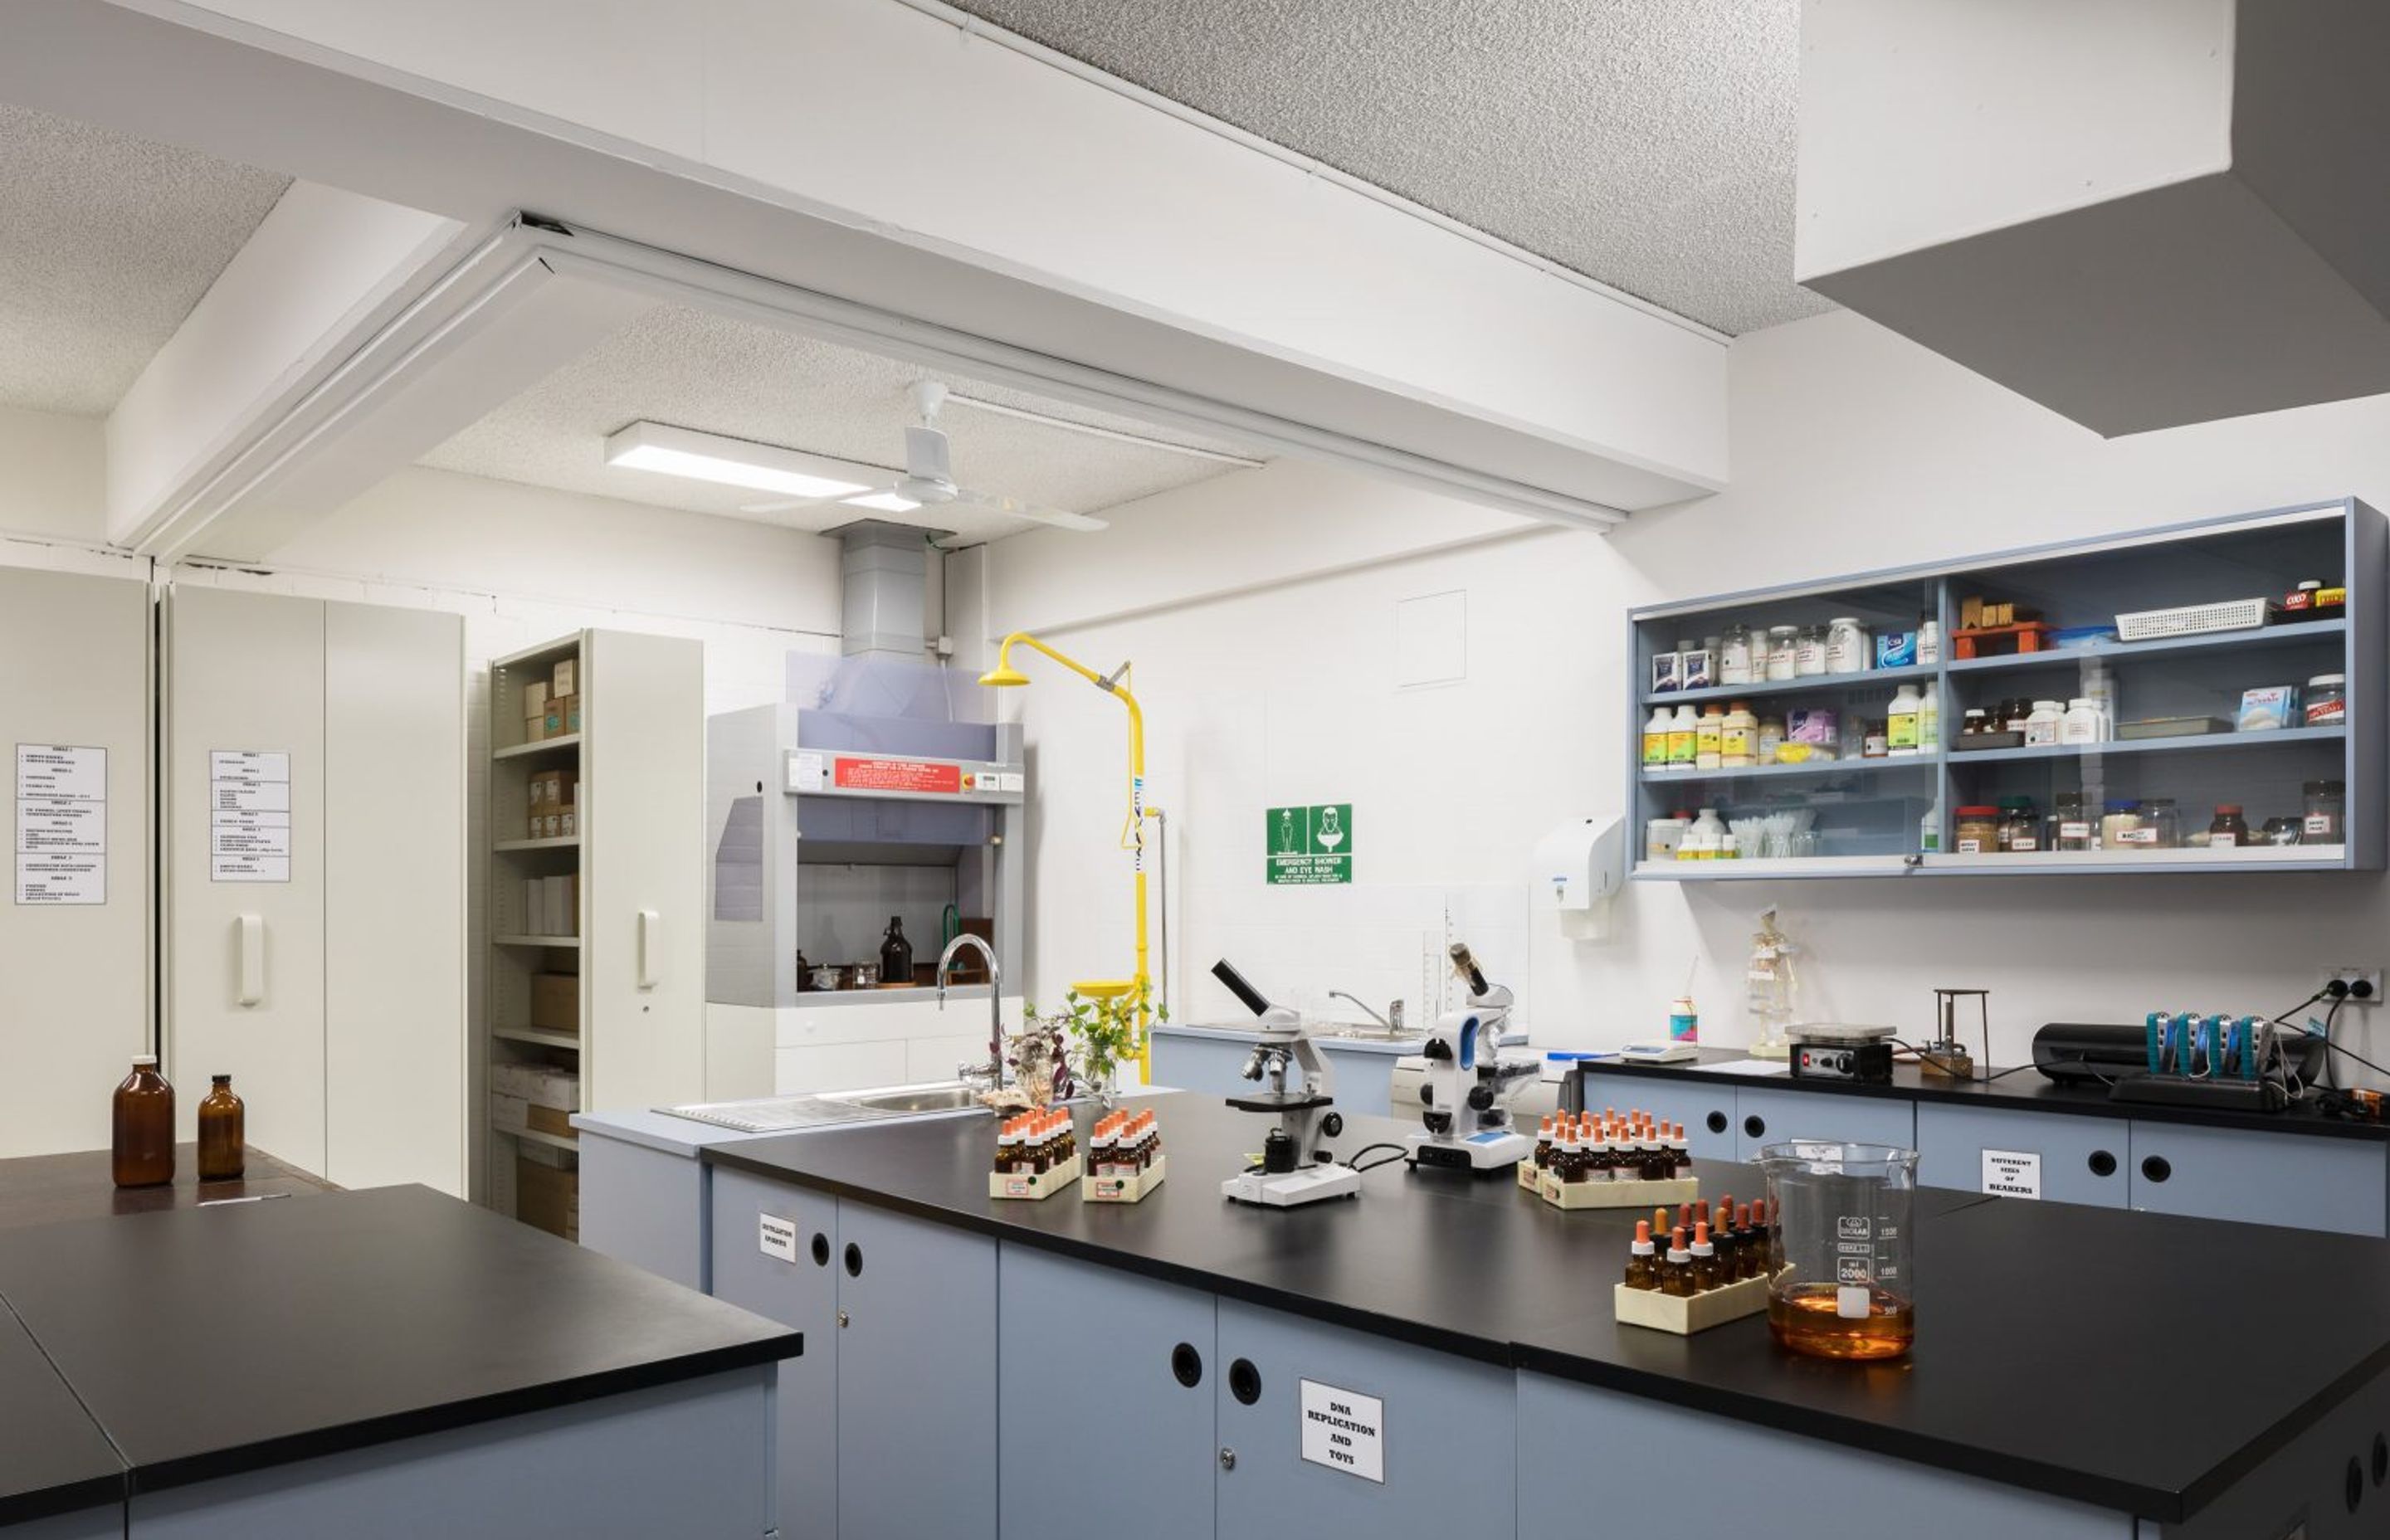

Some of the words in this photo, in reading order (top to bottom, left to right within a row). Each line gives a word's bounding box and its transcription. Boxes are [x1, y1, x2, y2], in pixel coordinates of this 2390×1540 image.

[1275, 858, 1312, 866] EMERGENCY
[1314, 857, 1342, 865] SHOWER
[1314, 865, 1333, 874] WASH
[1991, 1157, 2032, 1167] DIFFERENT
[1988, 1183, 2032, 1195] BEAKERS
[1841, 1267, 1867, 1279] 2000
[1330, 1401, 1352, 1416] DNA
[1307, 1409, 1376, 1437] REPLICATION
[1329, 1433, 1352, 1446] AND
[1329, 1450, 1354, 1464] TOYS
